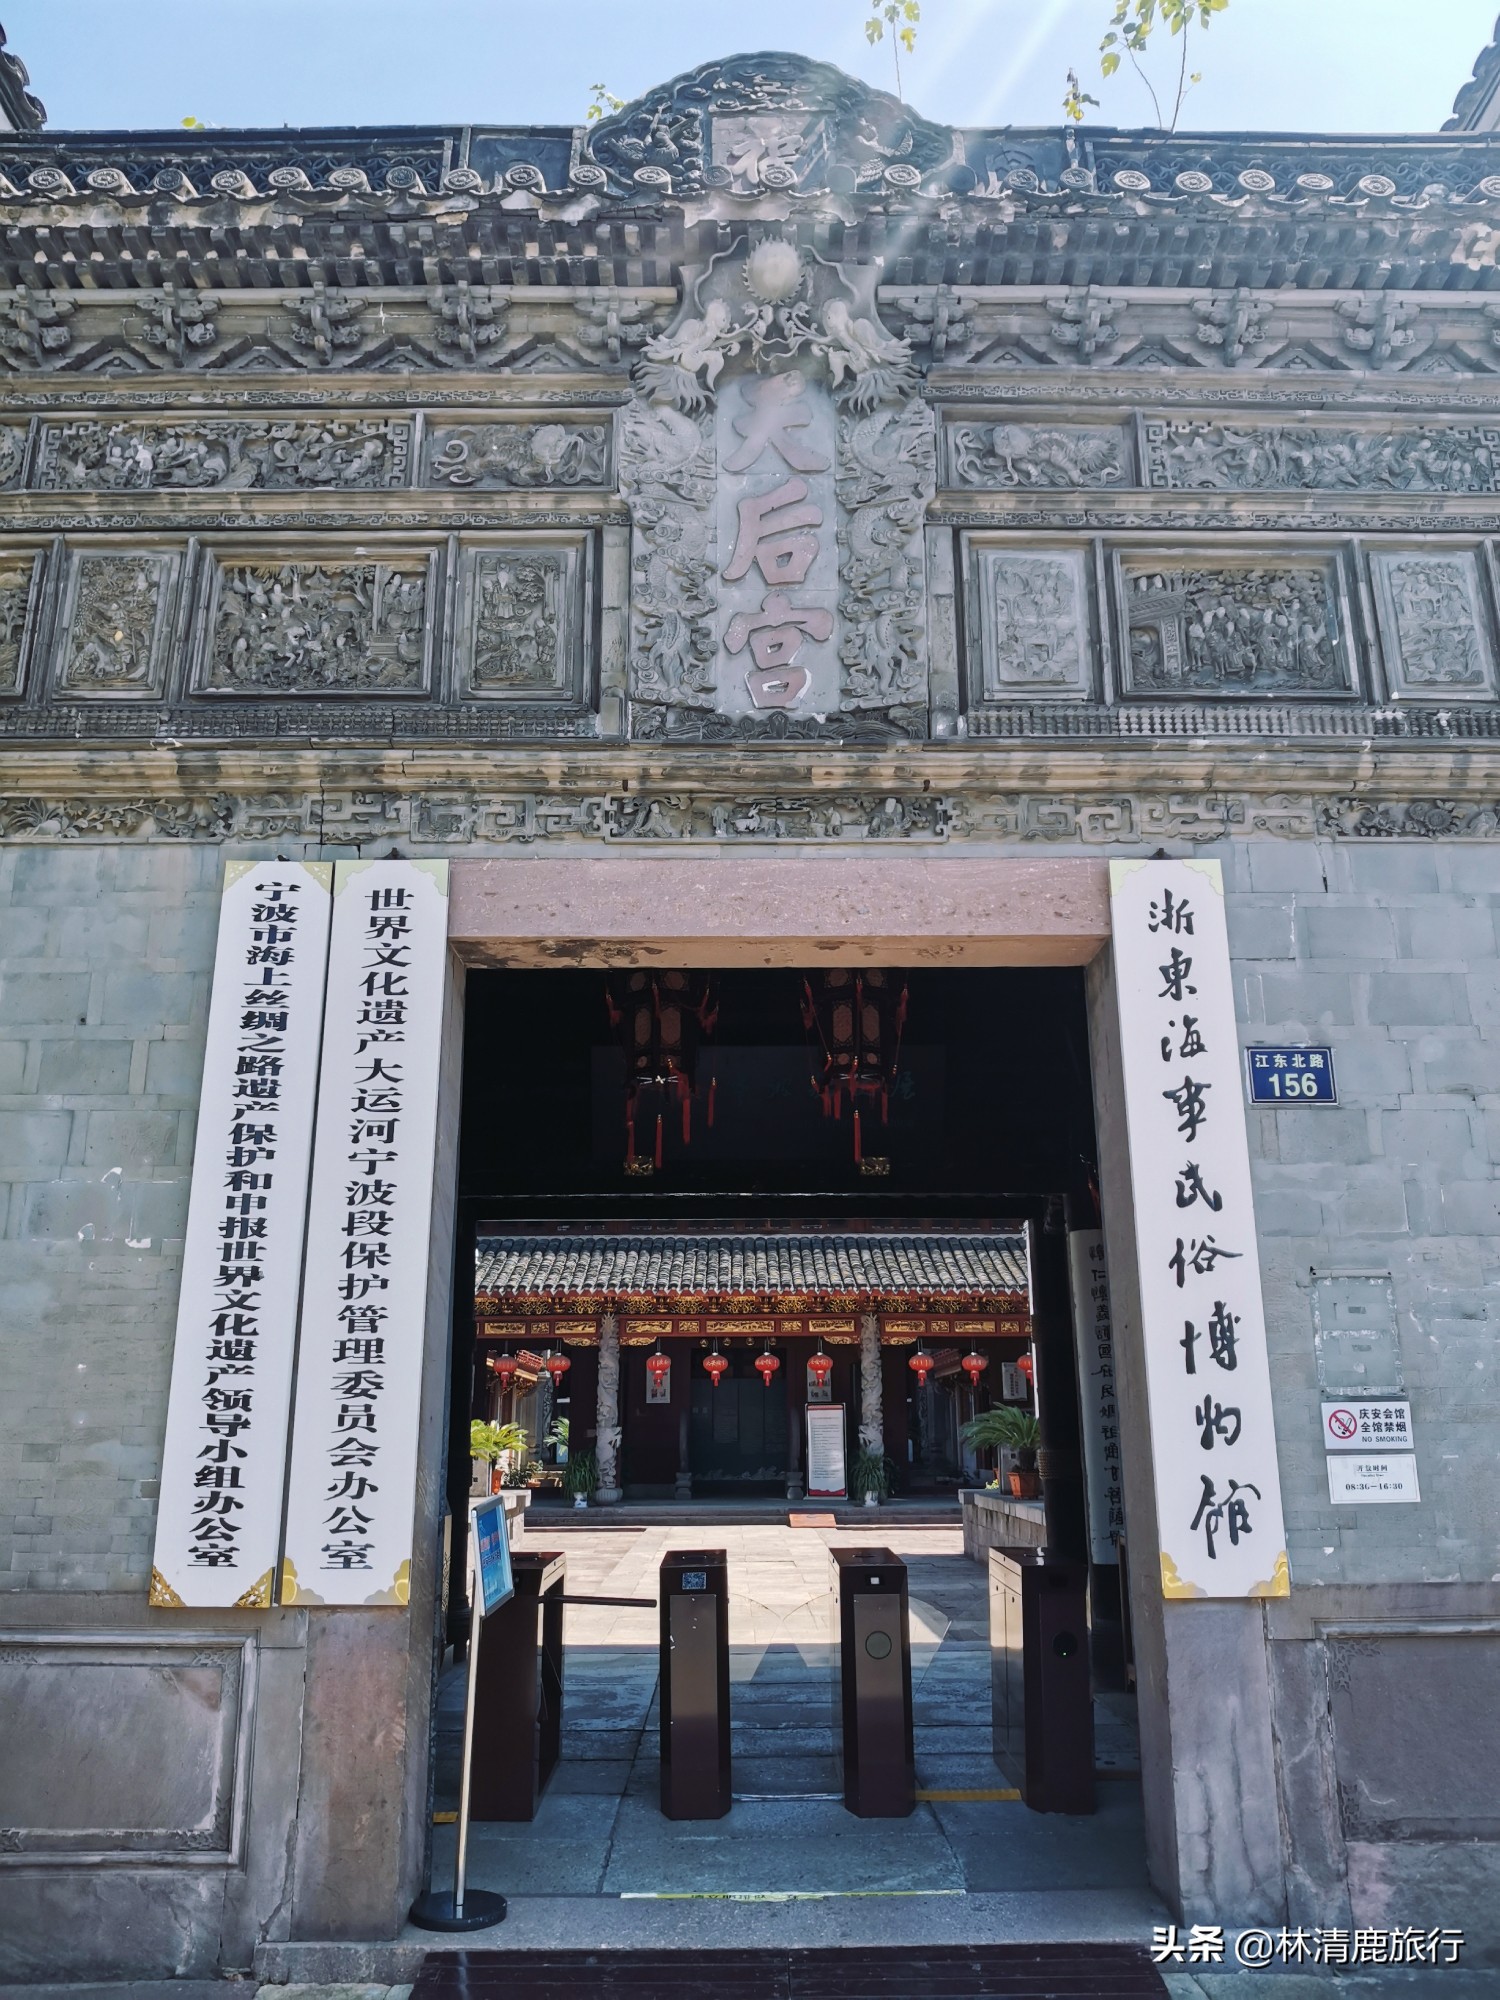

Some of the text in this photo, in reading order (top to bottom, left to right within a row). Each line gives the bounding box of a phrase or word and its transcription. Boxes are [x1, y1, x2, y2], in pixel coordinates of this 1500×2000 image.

[721, 369, 834, 709] 天后宫
[1254, 1053, 1324, 1068] 江东北路
[1268, 1072, 1318, 1097] 156
[187, 881, 302, 1568] 宁波市海上丝绸之路遗产保护和申报世界文化遗产领导小组办公室
[320, 888, 415, 1570] 世界文化遗产大运河宁波段保护管理委员会办公室
[1359, 1408, 1405, 1420] 庆安会馆
[1360, 1421, 1407, 1433] 全馆禁烟
[1361, 1435, 1408, 1443] NO SMOKING
